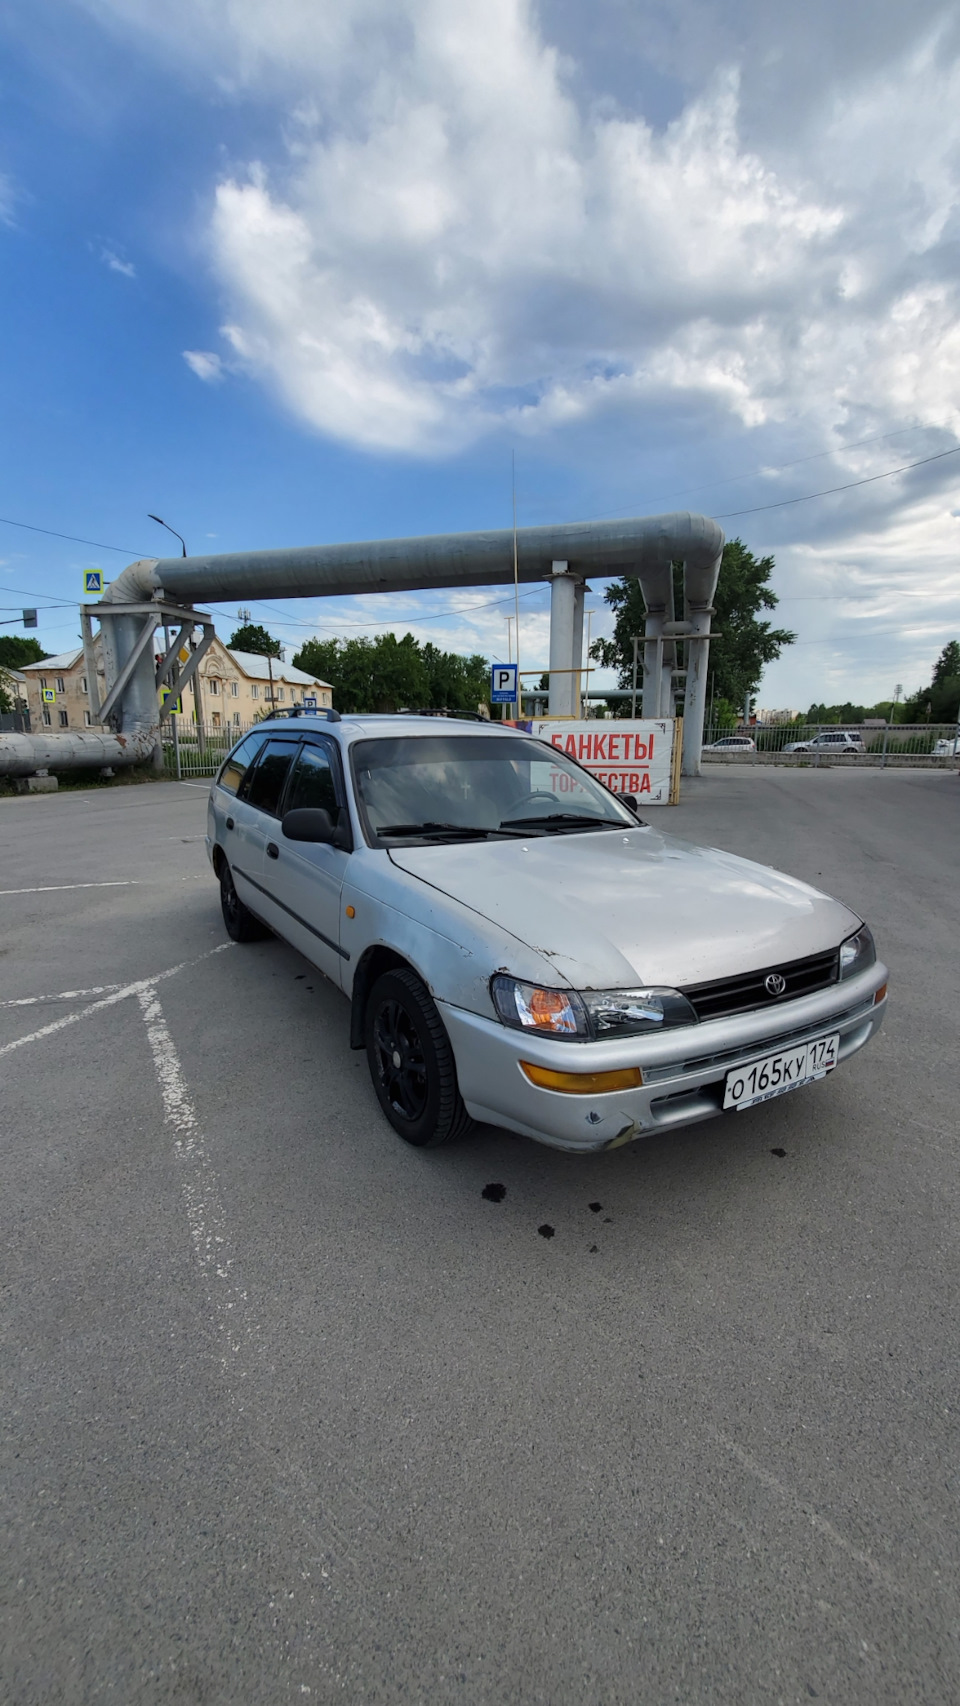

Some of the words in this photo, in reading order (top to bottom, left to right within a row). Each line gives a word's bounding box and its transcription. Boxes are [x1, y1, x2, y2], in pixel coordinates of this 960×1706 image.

[499, 671, 510, 689] P
[551, 734, 654, 760] БАНКЕТЫ
[549, 773, 651, 794] ТОРЕСТВА
[732, 1056, 805, 1100] О165КУ
[809, 1039, 835, 1063] 174
[812, 1061, 826, 1072] RUS
